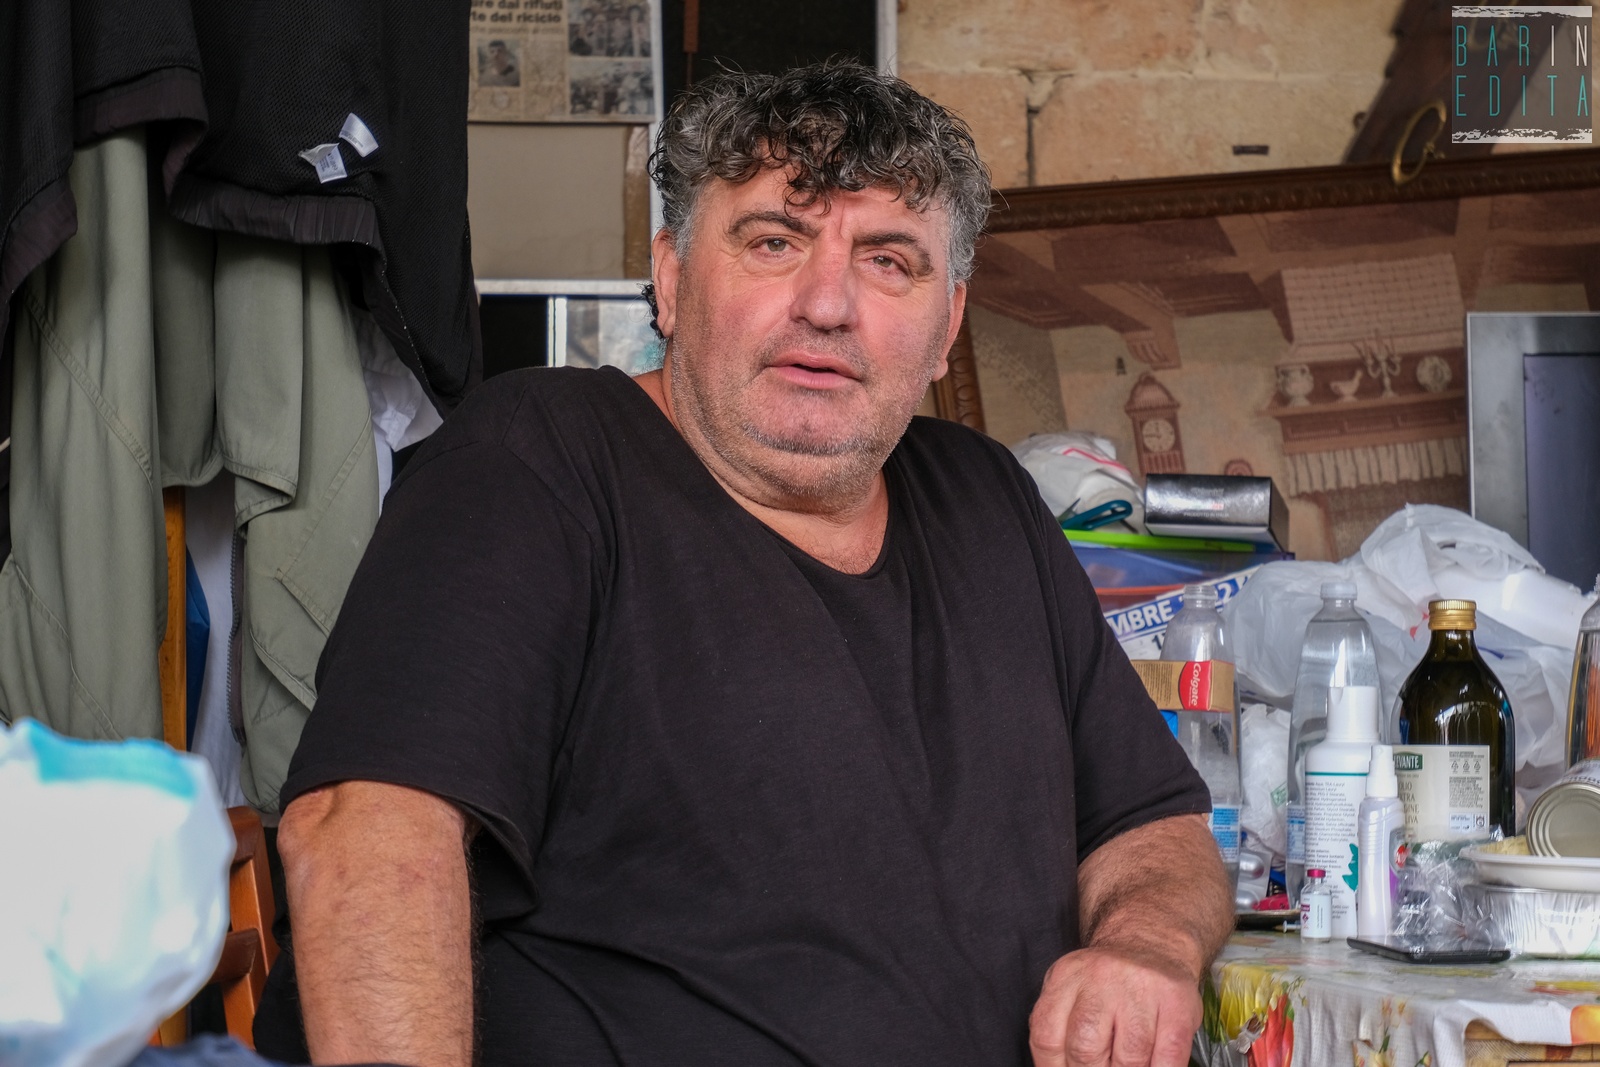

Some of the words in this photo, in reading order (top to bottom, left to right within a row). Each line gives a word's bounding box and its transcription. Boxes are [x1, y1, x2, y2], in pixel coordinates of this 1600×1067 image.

[490, 11, 513, 22] del
[516, 12, 562, 23] riciclo
[1190, 663, 1201, 706] Colgate
